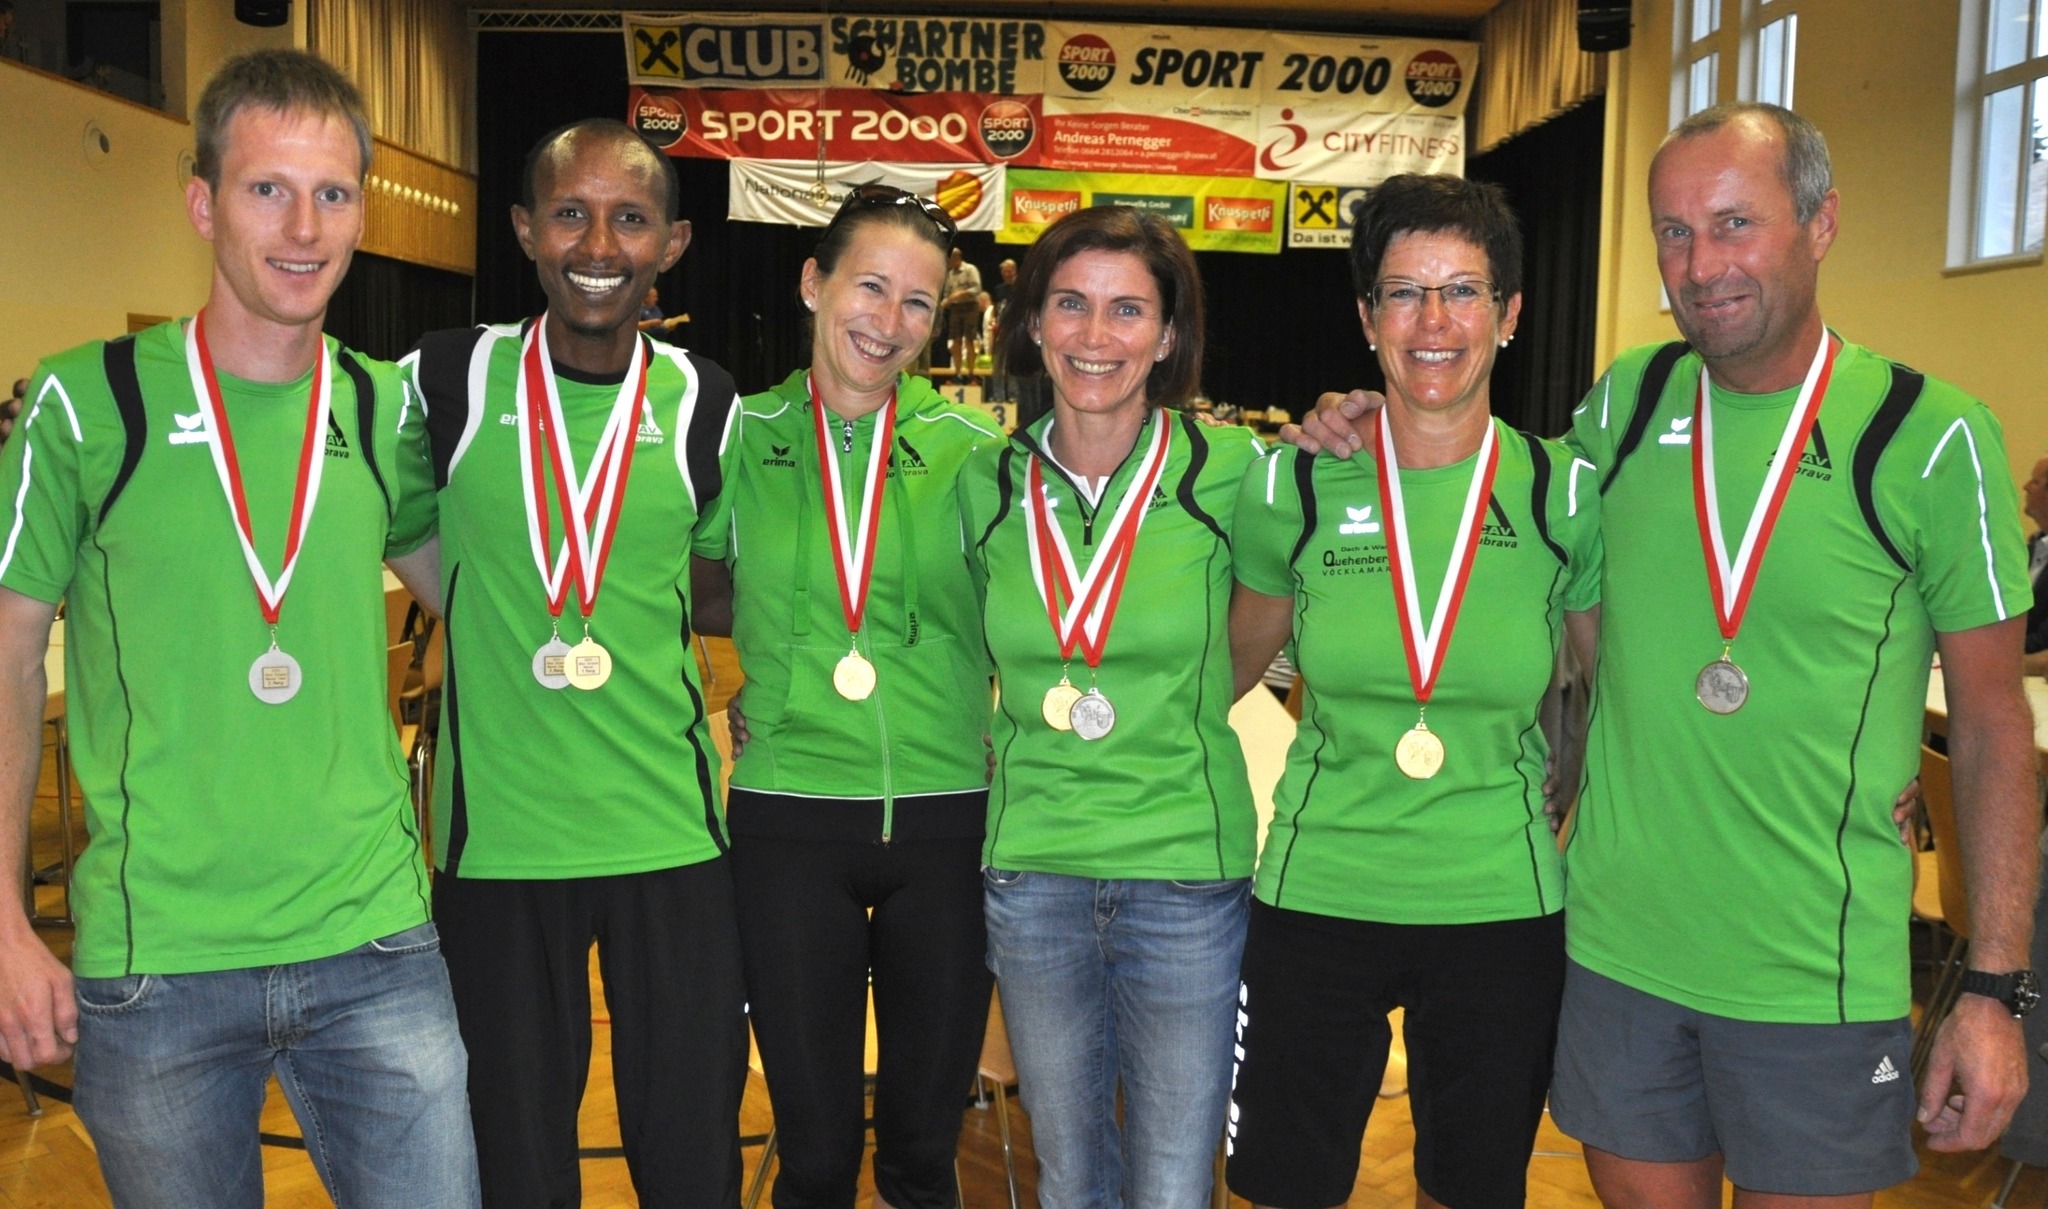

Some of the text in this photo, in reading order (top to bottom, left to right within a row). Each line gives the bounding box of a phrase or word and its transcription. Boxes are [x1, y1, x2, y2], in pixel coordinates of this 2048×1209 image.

[831, 16, 1045, 60] SCHARTNER
[685, 27, 820, 77] CLUB
[1061, 45, 1110, 62] SPORT
[897, 57, 1017, 95] BOMBE
[1066, 64, 1109, 81] 2000
[1129, 47, 1392, 95] SPORT 2000
[1408, 61, 1457, 77] SPORT
[1413, 80, 1455, 96] 2000
[639, 105, 682, 124] SPORT
[642, 118, 680, 131] 2000
[701, 109, 968, 144] SPORT 2000
[983, 117, 1030, 130] SPORT
[987, 129, 1025, 141] 2000
[1053, 130, 1172, 151] Andreas Pernegger
[1014, 196, 1078, 214] Knusperli
[1208, 203, 1271, 222] Knusperli
[1293, 232, 1313, 243] Da
[1318, 232, 1337, 243] ist
[954, 388, 965, 404] 1
[992, 405, 1006, 427] 3
[762, 456, 796, 468] erima
[1323, 549, 1389, 567] Quehenber
[1321, 565, 1392, 577] VÖCKLAMAR
[907, 612, 920, 645] erima
[1872, 1070, 1900, 1084] adidas
